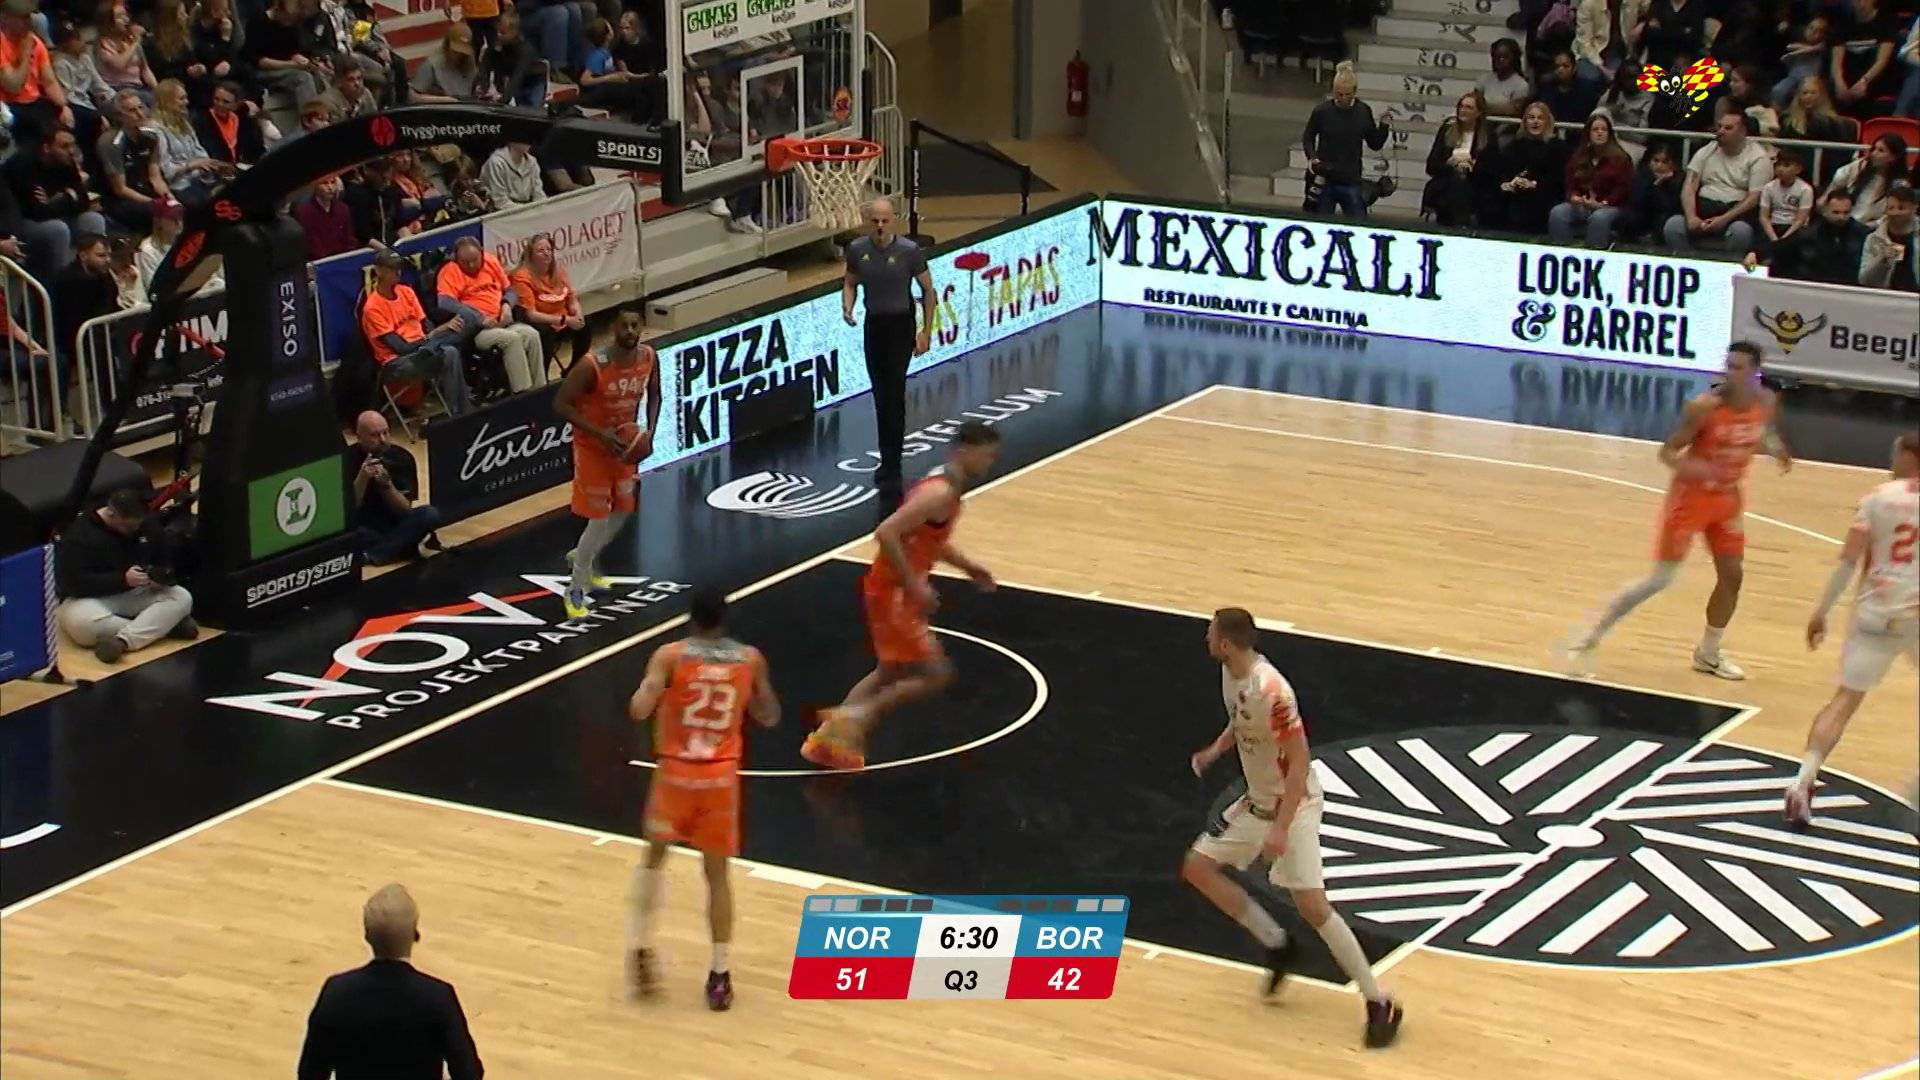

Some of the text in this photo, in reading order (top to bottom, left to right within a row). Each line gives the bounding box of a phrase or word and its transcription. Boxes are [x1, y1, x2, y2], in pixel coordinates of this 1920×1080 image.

[400, 124, 503, 140] Trygghetspartner
[1087, 207, 1444, 301] MEXICALI
[1518, 252, 1700, 308] LOCK, HOP
[918, 285, 959, 346] AS
[981, 246, 1060, 328] TAPAS
[1144, 287, 1369, 328] RESTAURANTE Y CANTINA
[280, 281, 298, 357] EXISO
[1511, 299, 1696, 359] & BARREL
[682, 318, 789, 397] PIZZA
[247, 553, 354, 605] SPORTSYSTEM
[204, 573, 650, 721] NOVA
[682, 682, 737, 730] 23
